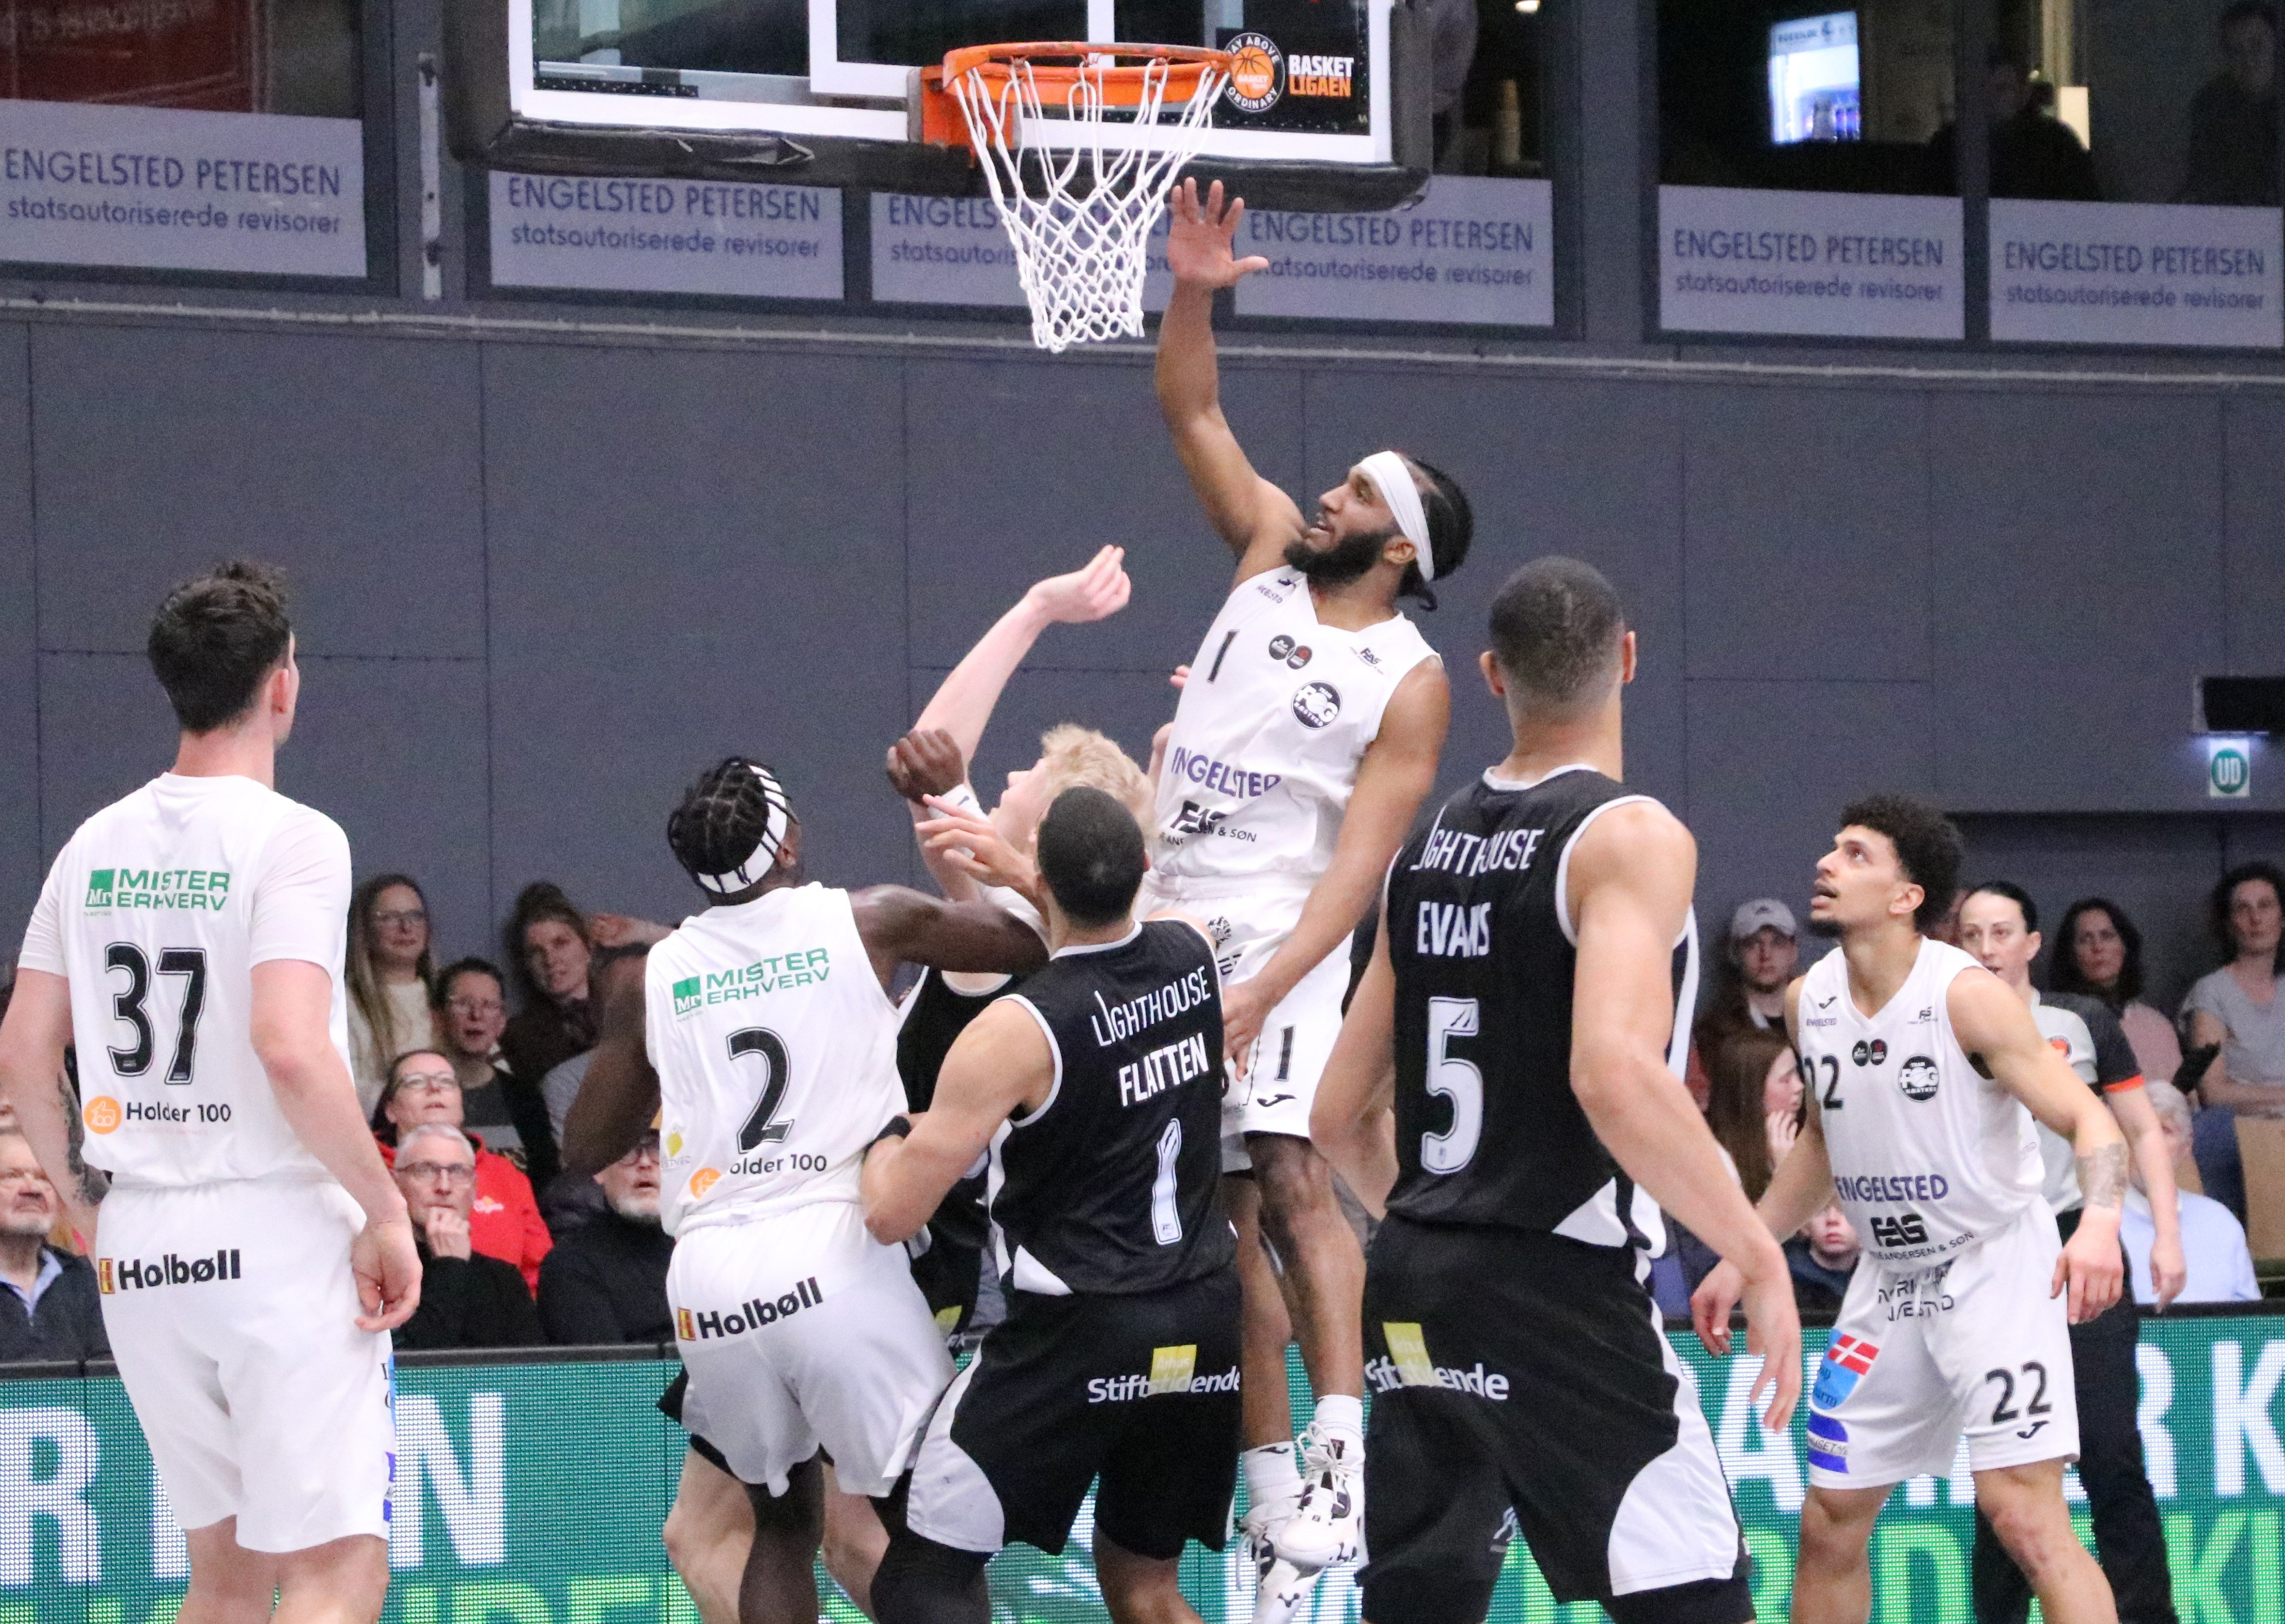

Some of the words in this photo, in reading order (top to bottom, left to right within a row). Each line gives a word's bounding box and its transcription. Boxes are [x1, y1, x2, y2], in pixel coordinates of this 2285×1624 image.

[1245, 35, 1280, 64] ABOVE
[1288, 54, 1355, 77] BASKET
[1229, 85, 1277, 109] ORDINARY
[1288, 74, 1352, 98] LIGAEN
[5, 148, 184, 189] ENGELSTED
[198, 159, 341, 196] PETERSEN
[8, 197, 228, 229] statsautoriserede
[238, 210, 340, 235] revisorer
[508, 177, 674, 213] ENGELSTED
[685, 185, 820, 221] PETERSEN
[888, 196, 1020, 230] ENGELS
[512, 224, 715, 253] statsautoriserede
[724, 235, 820, 259] revisorer
[1250, 212, 1401, 246] ENGELSTED
[1411, 218, 1533, 251] PETERSEN
[1674, 229, 1816, 262] ENGELSTED
[1827, 235, 1944, 266] PETERSEN
[1253, 257, 1436, 284] atsautoriserede
[1446, 267, 1532, 286] revisorer
[2005, 241, 2142, 274] ENGELSTED
[2153, 246, 2264, 276] PETERSEN
[1676, 271, 1852, 298] statsautoriserede
[1860, 278, 1943, 300] revisorer
[2007, 285, 2176, 307] statsautoriserede
[2184, 287, 2264, 309] revisorer
[1207, 629, 1240, 684] 1
[2218, 757, 2241, 785] UD
[118, 868, 230, 893] MISTER
[116, 892, 227, 911] ERHVERV
[706, 947, 830, 989] MISTER
[707, 966, 830, 1005] ERHVERV
[105, 941, 208, 1086] 37
[1091, 965, 1212, 1047] LIGHTHOUSE
[1119, 1032, 1210, 1107] FLATTEN
[1274, 1024, 1297, 1082] 1
[725, 1026, 795, 1154] 2
[1421, 995, 1484, 1175] 5
[126, 1101, 190, 1122] Holder
[197, 1103, 232, 1122] 100
[729, 1157, 784, 1175] older
[790, 1153, 827, 1172] 100
[1150, 1118, 1183, 1245] 1
[1835, 1174, 1949, 1203] ENGELSTED
[1938, 1244, 1946, 1252] &
[118, 1249, 241, 1291] Holbøll
[697, 1277, 824, 1340] Holbøll
[1985, 1360, 2053, 1424] 22
